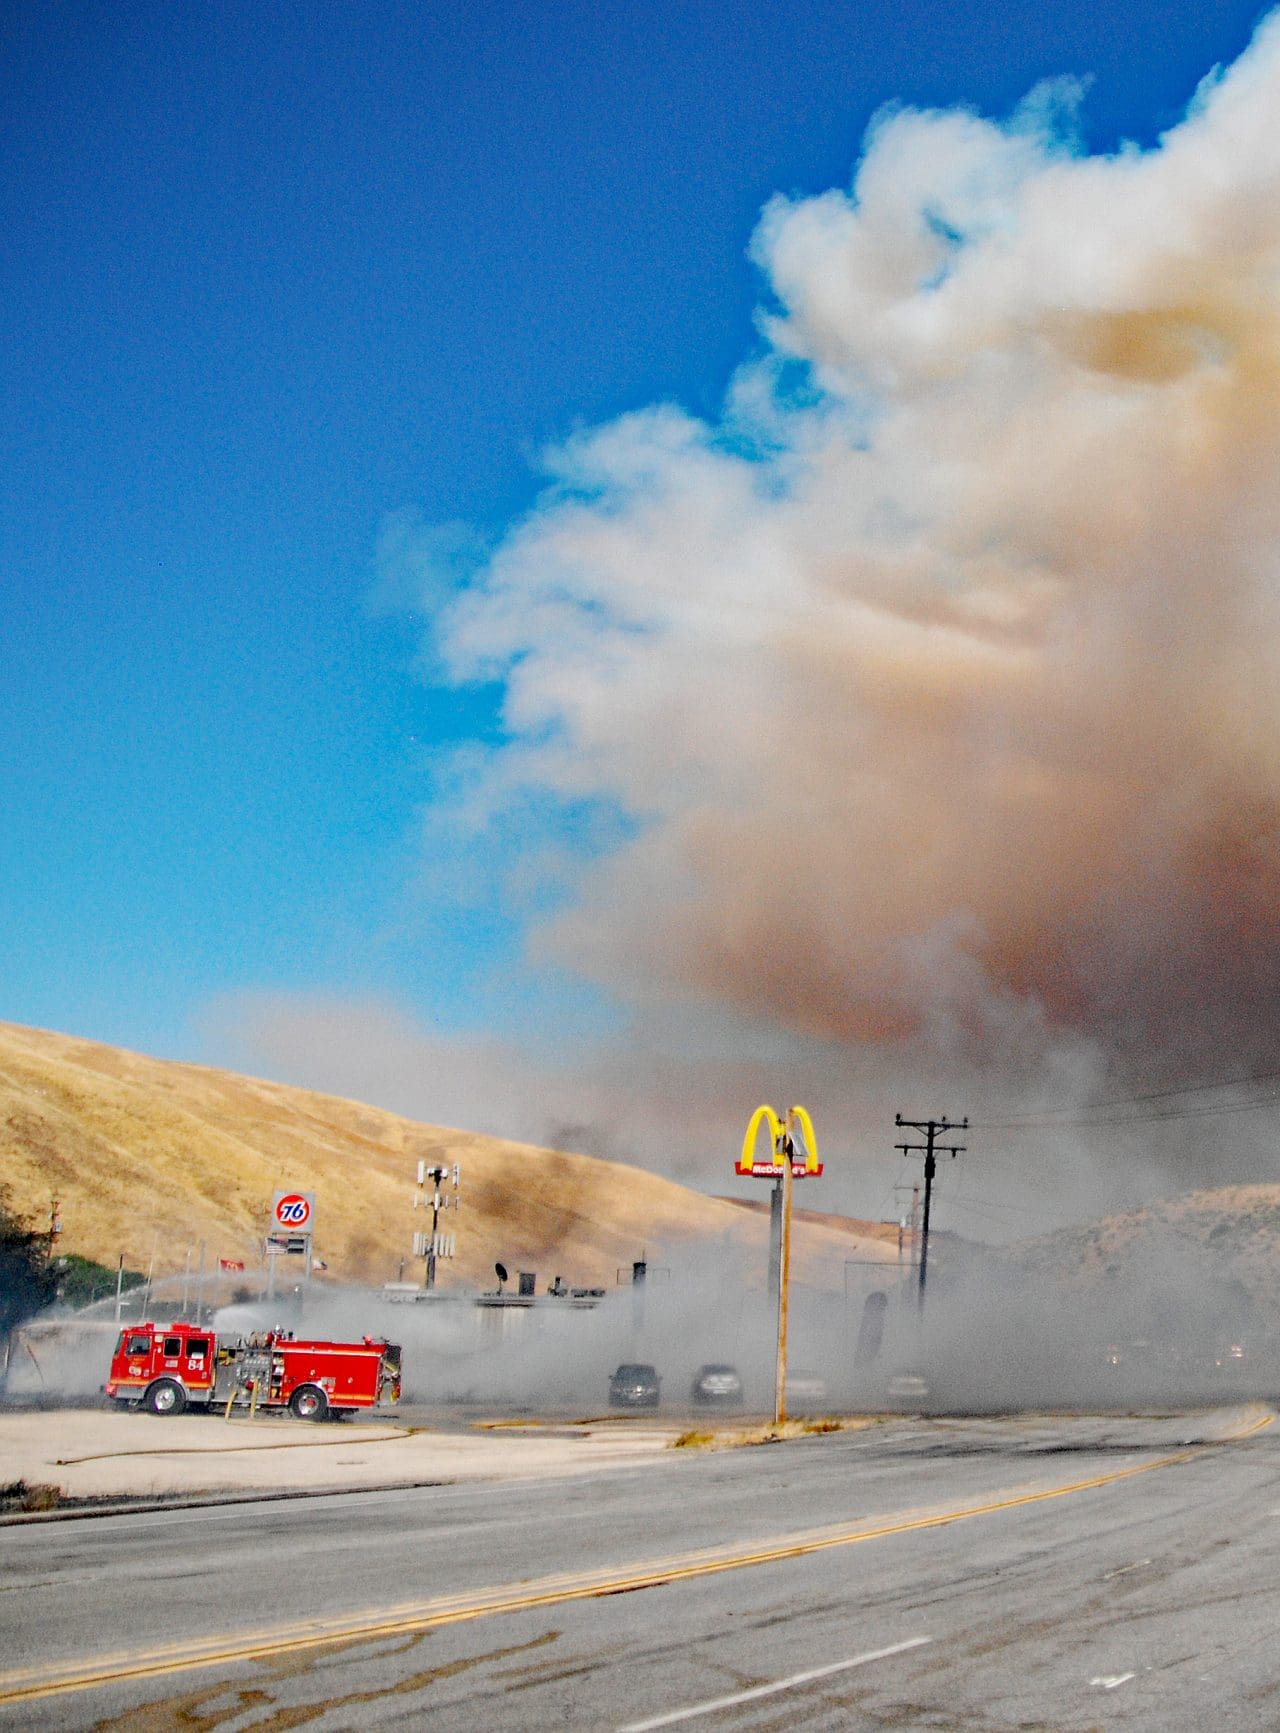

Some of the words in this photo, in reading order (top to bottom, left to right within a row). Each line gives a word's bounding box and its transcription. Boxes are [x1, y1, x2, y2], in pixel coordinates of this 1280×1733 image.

[753, 1165, 805, 1174] McDond's
[281, 1202, 305, 1221] 76
[188, 1360, 203, 1370] 84
